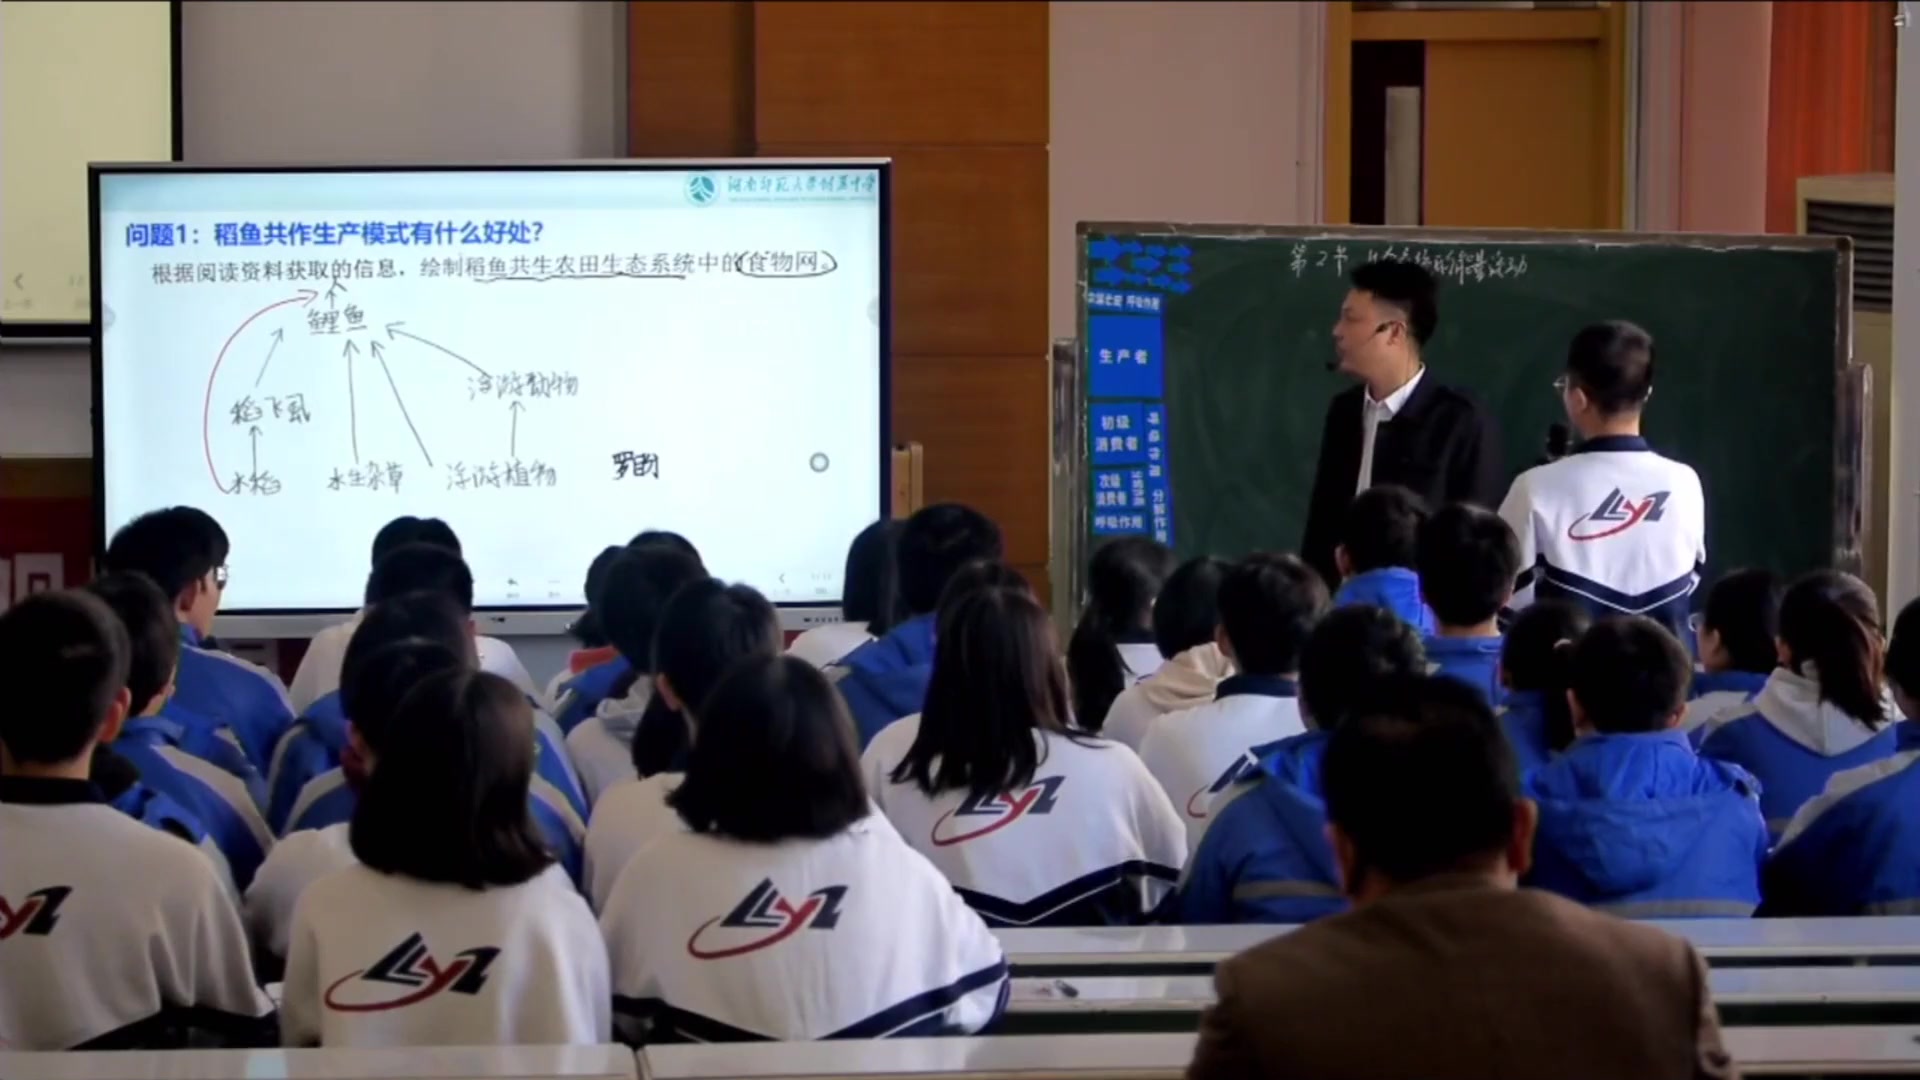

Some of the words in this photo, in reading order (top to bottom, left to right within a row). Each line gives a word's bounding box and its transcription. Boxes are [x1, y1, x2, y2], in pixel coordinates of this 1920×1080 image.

[307, 303, 368, 334] 鲤鱼
[1099, 348, 1149, 365] 生产者
[467, 370, 580, 401] 浮游动物
[1101, 415, 1131, 431] 初级
[1095, 436, 1139, 453] 消费者
[231, 470, 282, 496] 水稻
[326, 460, 404, 495] 水生杂草
[446, 458, 557, 490] 浮游植物
[1098, 473, 1122, 489] 次级
[1095, 491, 1128, 507] 消费者
